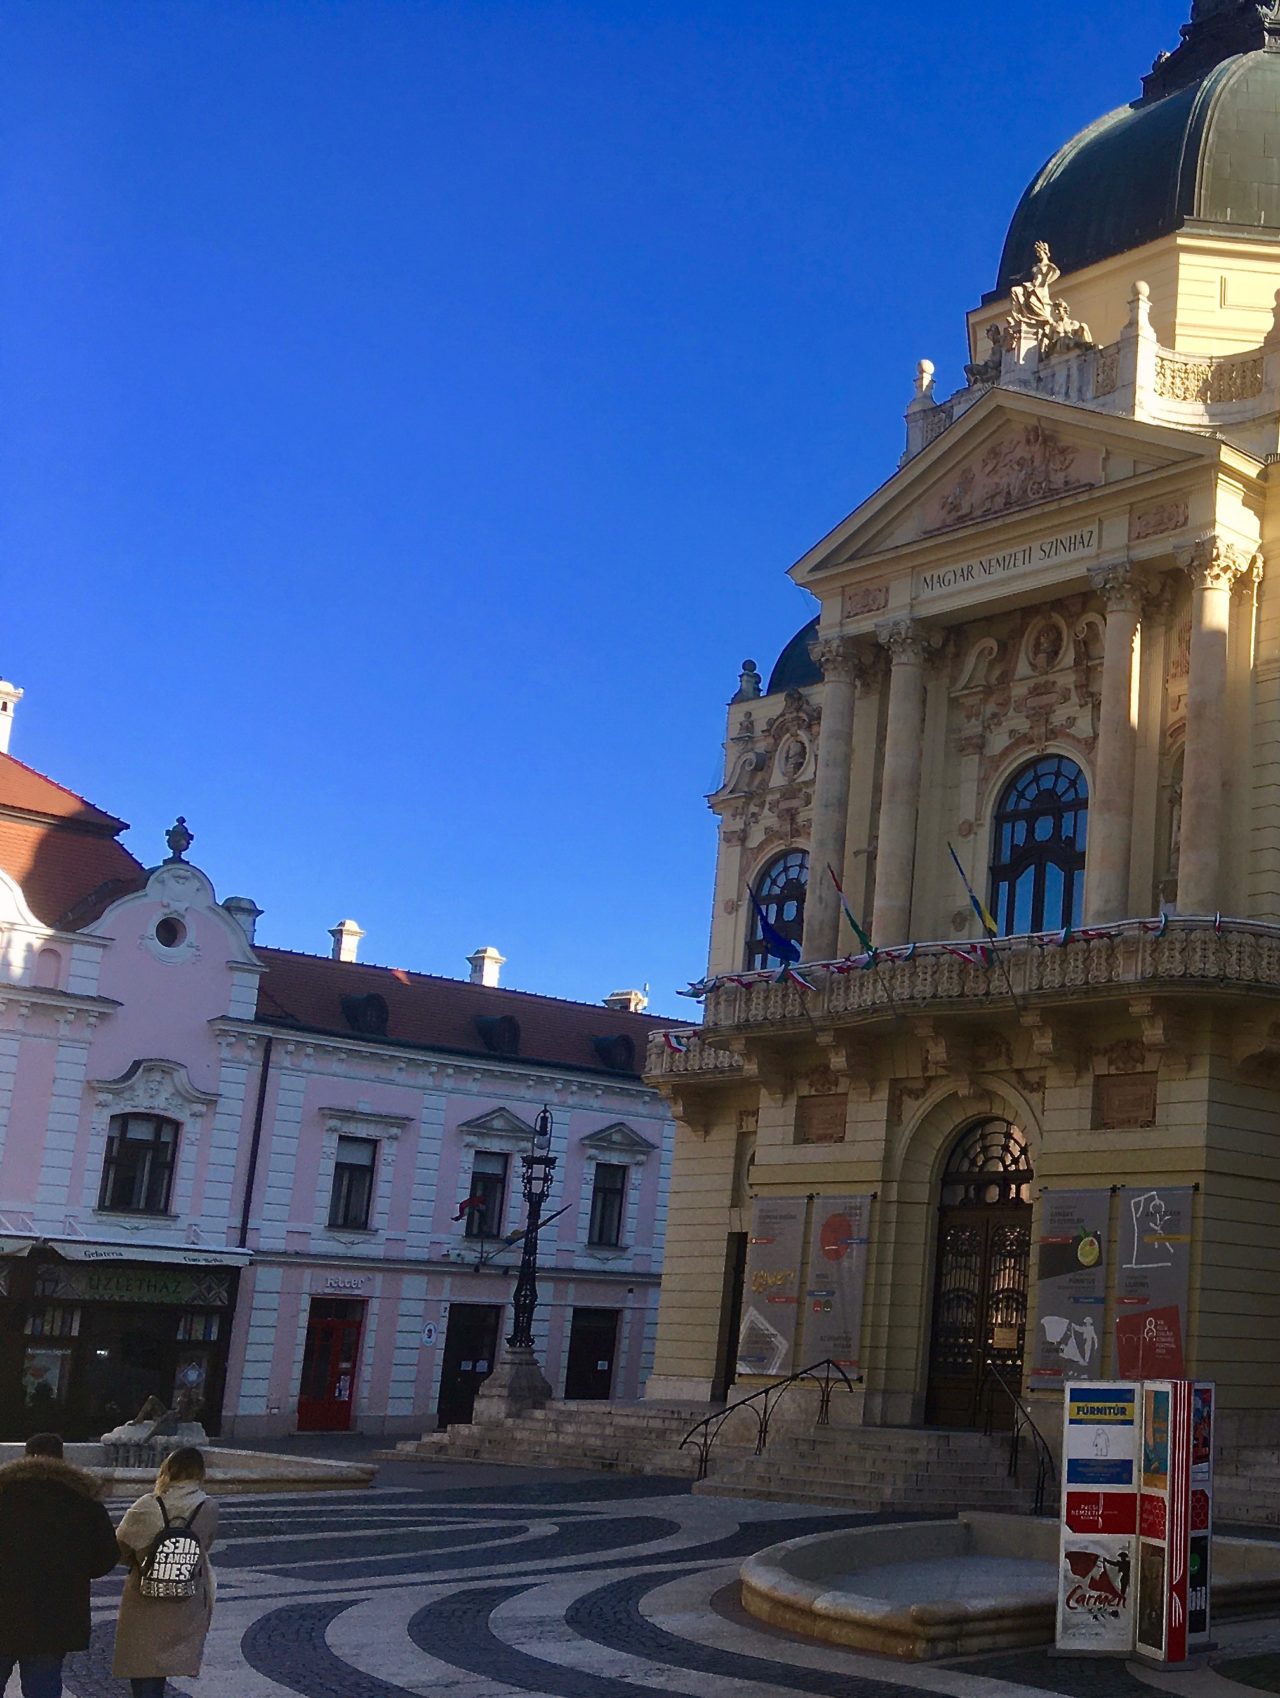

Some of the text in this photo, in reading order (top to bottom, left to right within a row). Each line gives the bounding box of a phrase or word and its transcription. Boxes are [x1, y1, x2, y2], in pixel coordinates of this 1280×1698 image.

[922, 564, 976, 593] MAGYAR
[978, 546, 1032, 576] NEMZETI
[84, 1250, 123, 1259] Gelateria
[1065, 1584, 1127, 1611] Carmen
